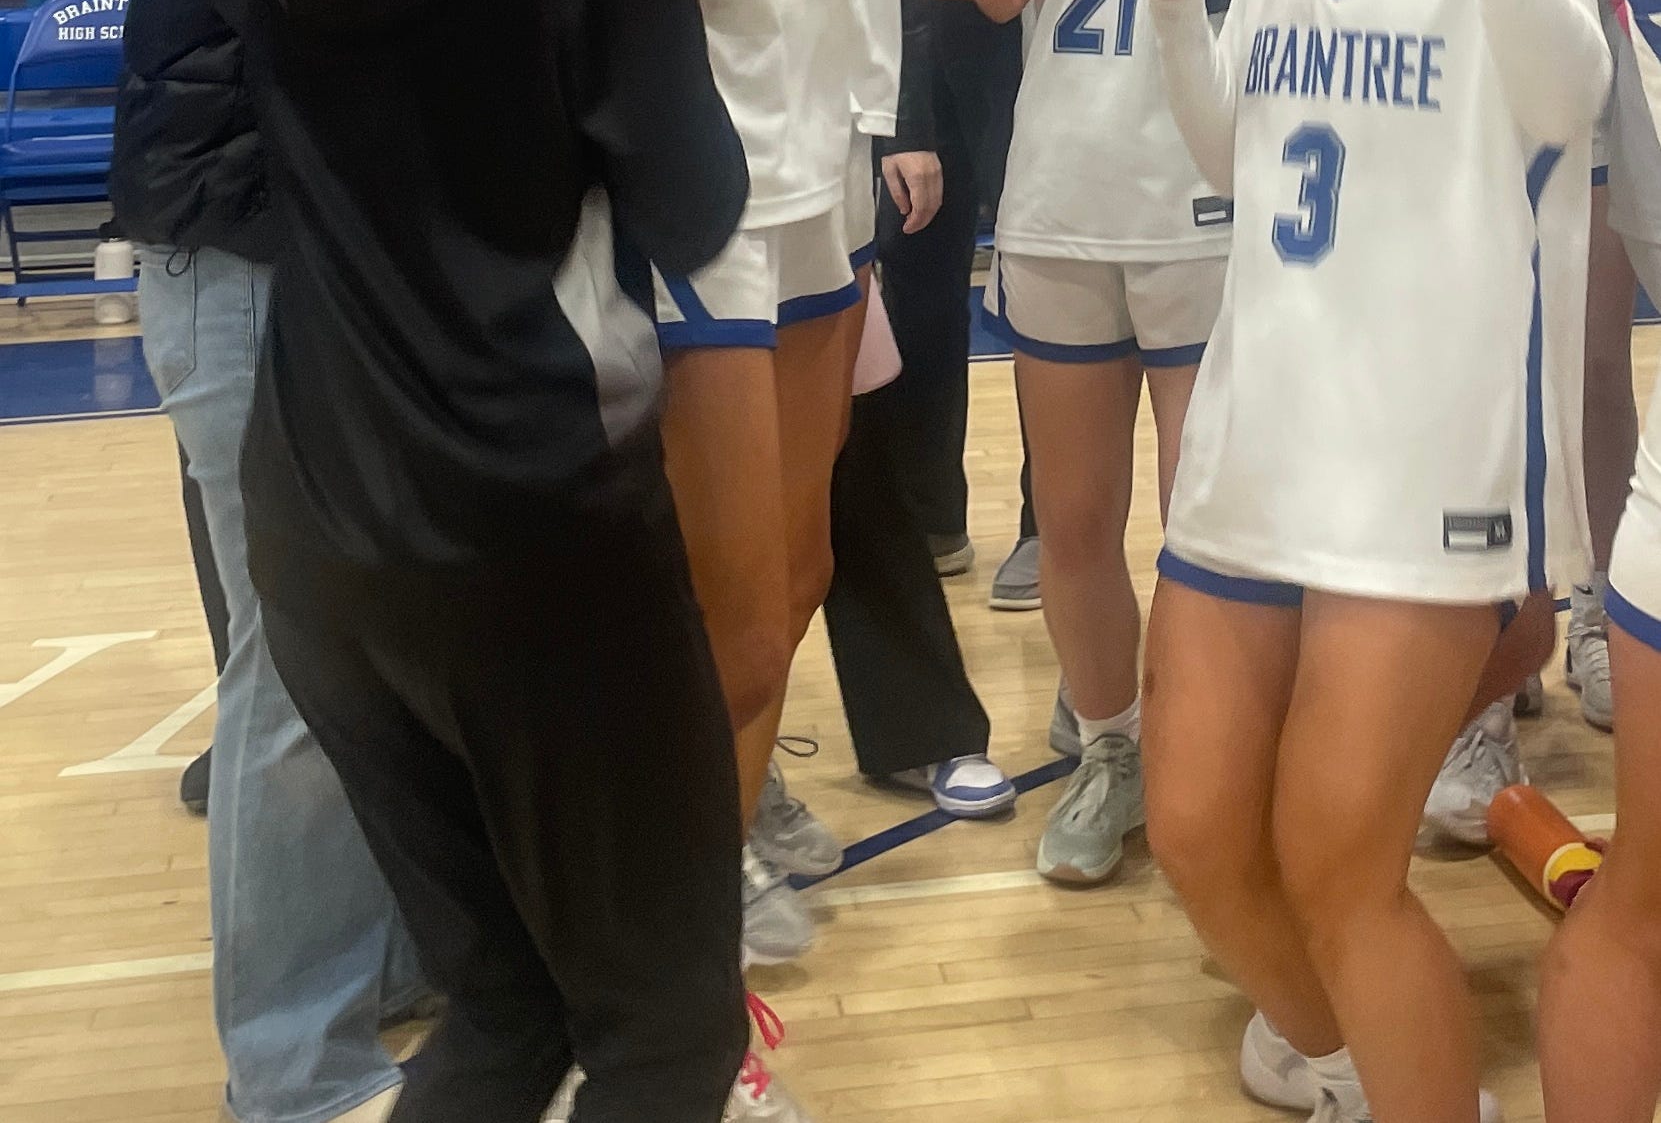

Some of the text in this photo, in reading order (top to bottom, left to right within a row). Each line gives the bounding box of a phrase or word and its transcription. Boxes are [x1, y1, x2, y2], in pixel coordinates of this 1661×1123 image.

[58, 26, 95, 41] HIGH
[1244, 23, 1446, 112] BRAINTREE
[1271, 121, 1346, 267] 3
